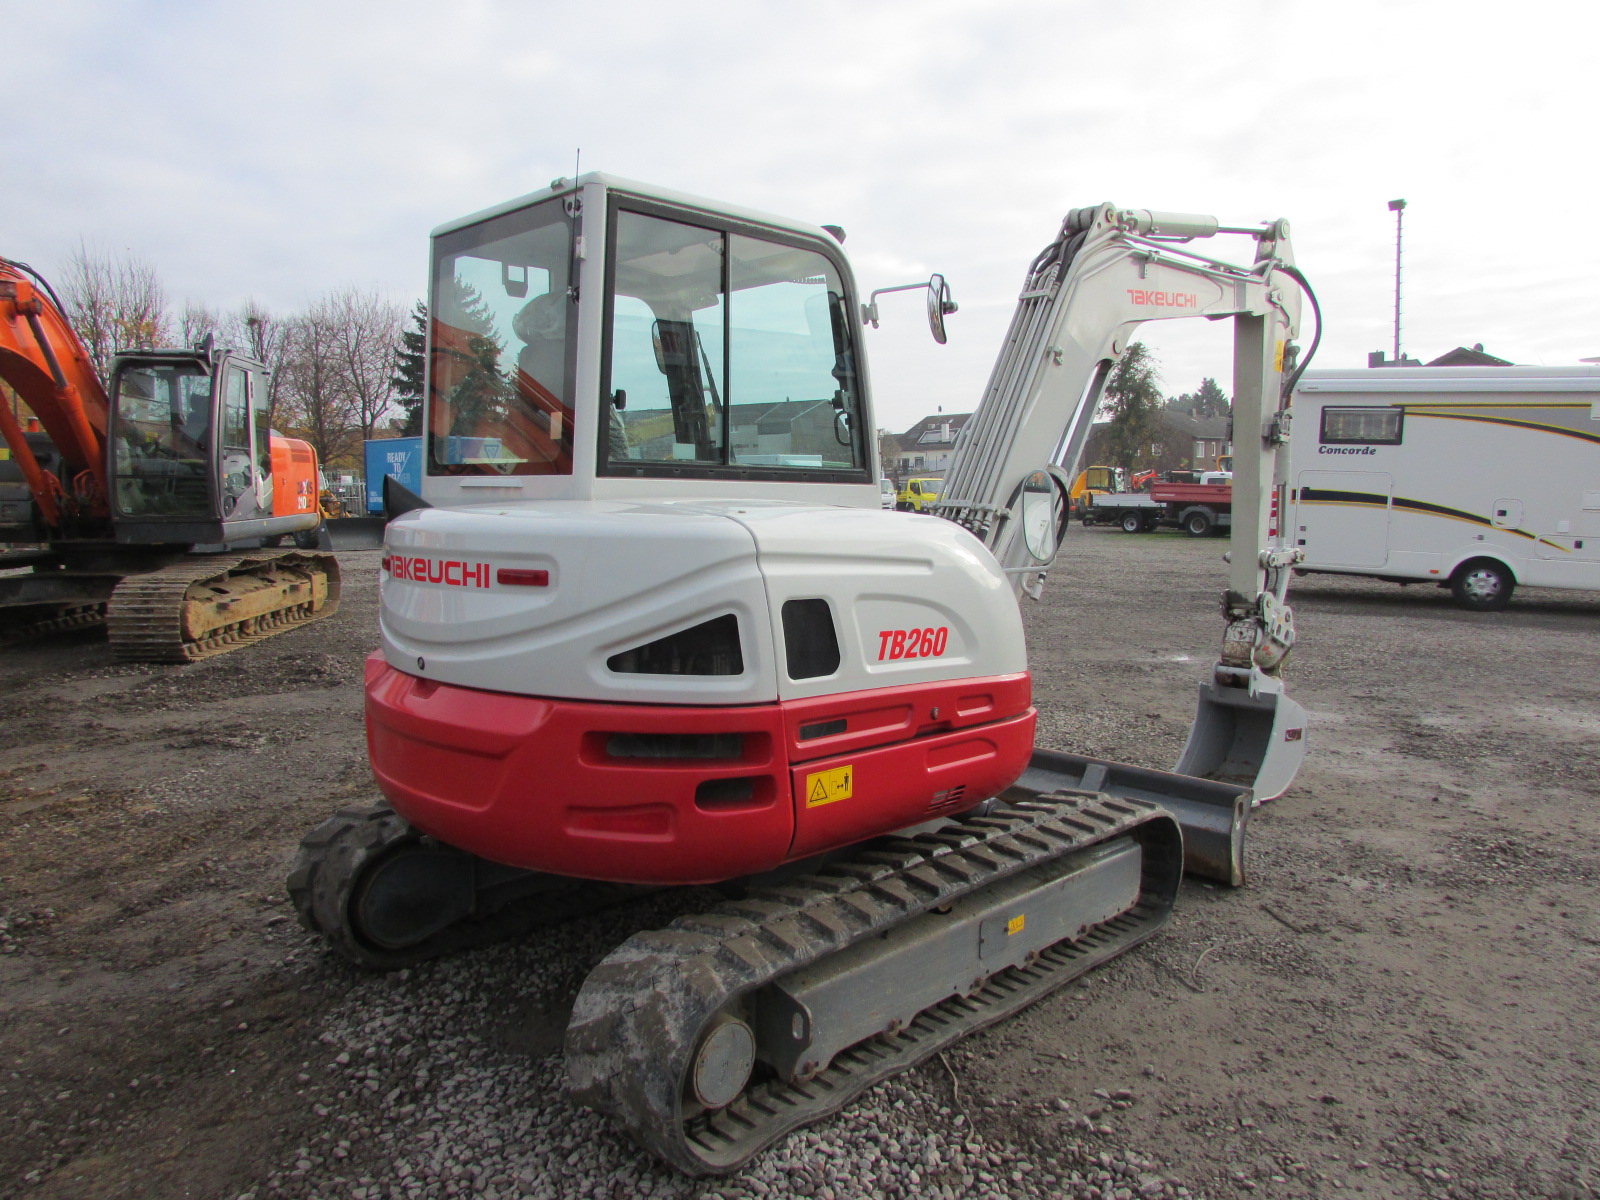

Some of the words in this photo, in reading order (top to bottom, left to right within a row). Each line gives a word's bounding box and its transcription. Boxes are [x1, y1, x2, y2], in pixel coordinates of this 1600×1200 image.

[1318, 445, 1376, 455] Concorde
[387, 452, 406, 463] READY
[393, 463, 401, 473] TO
[878, 627, 948, 661] TB260
